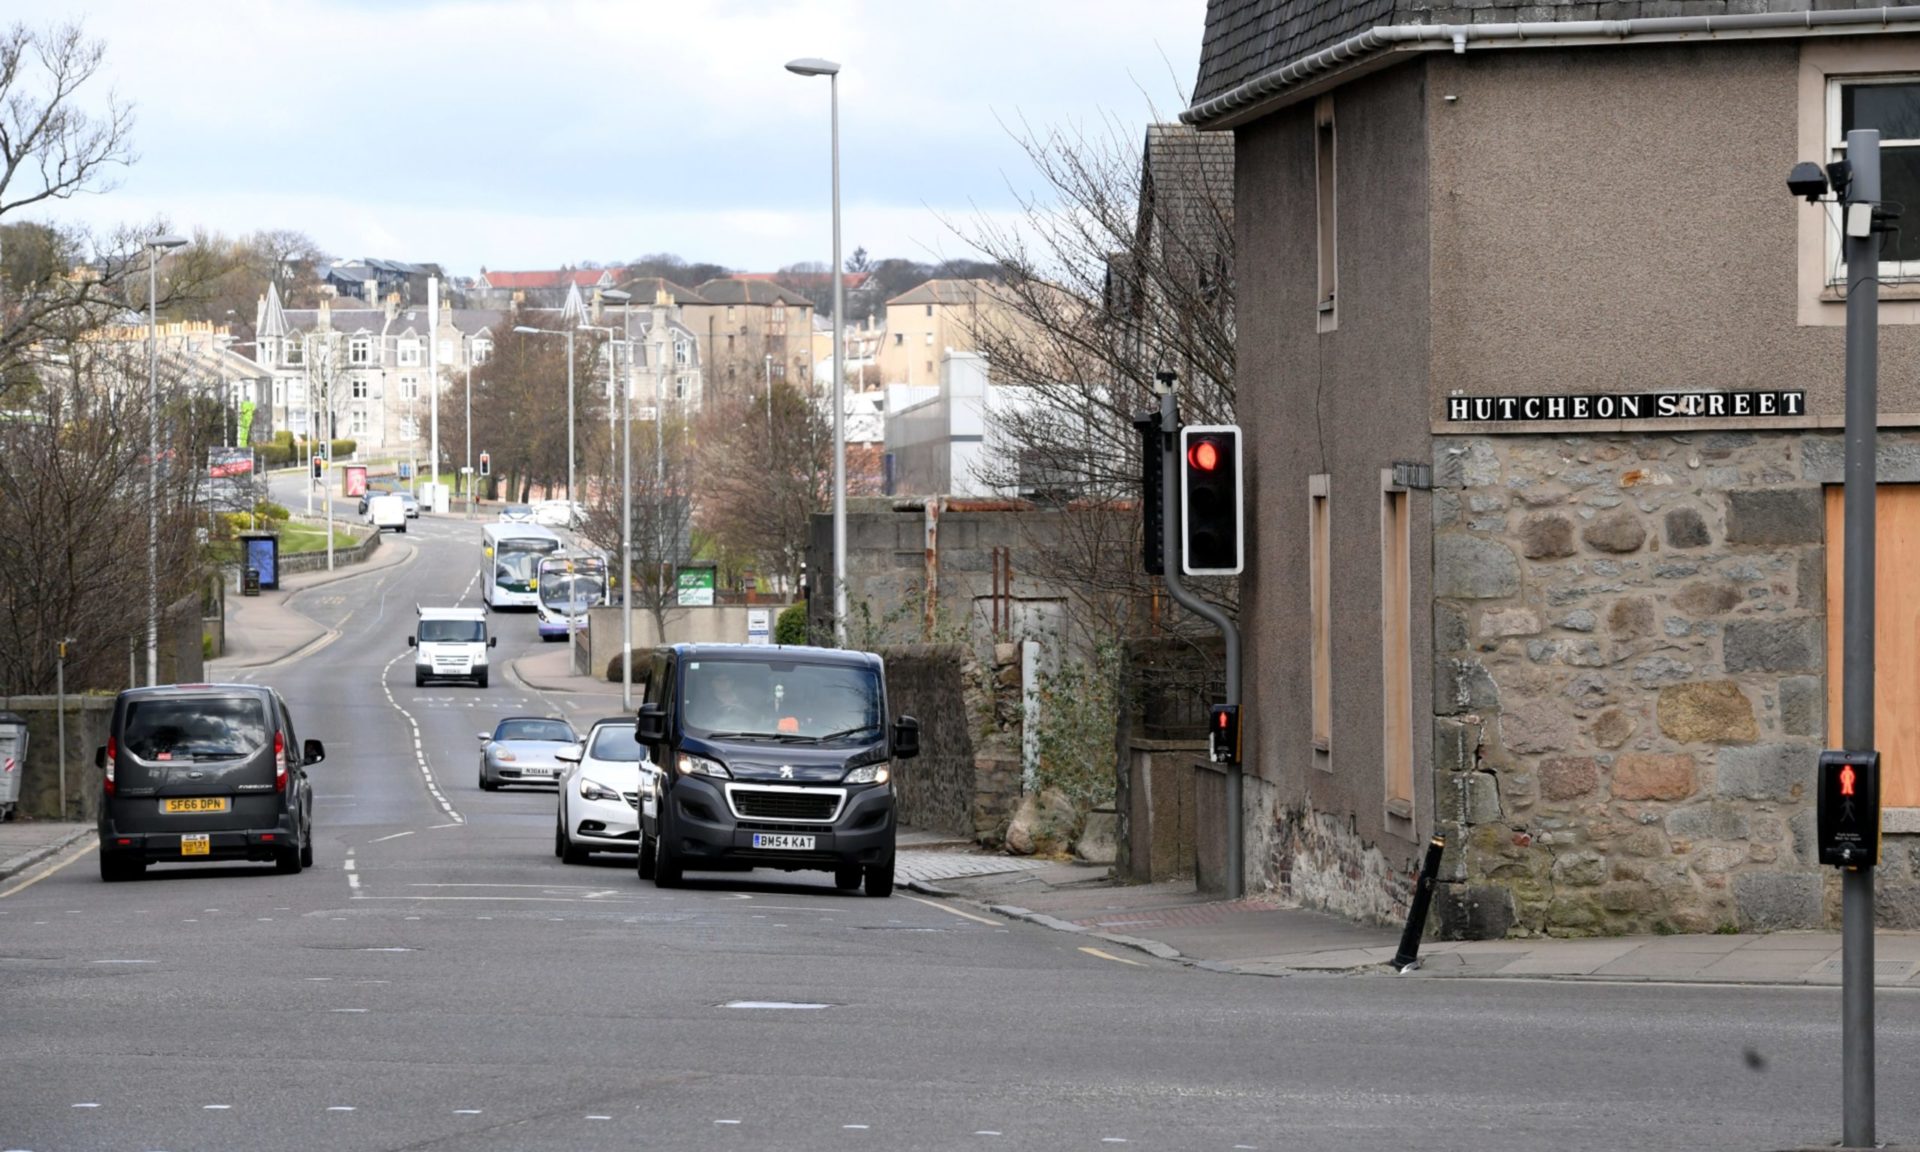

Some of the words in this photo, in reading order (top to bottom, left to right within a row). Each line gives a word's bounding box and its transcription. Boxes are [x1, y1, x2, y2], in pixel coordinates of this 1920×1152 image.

[1450, 397, 1640, 420] HUTCHEON
[1657, 392, 1803, 416] STREET
[170, 800, 198, 810] SF66
[200, 799, 221, 809] DPN
[760, 835, 789, 847] BM54
[791, 836, 814, 848] KAT
